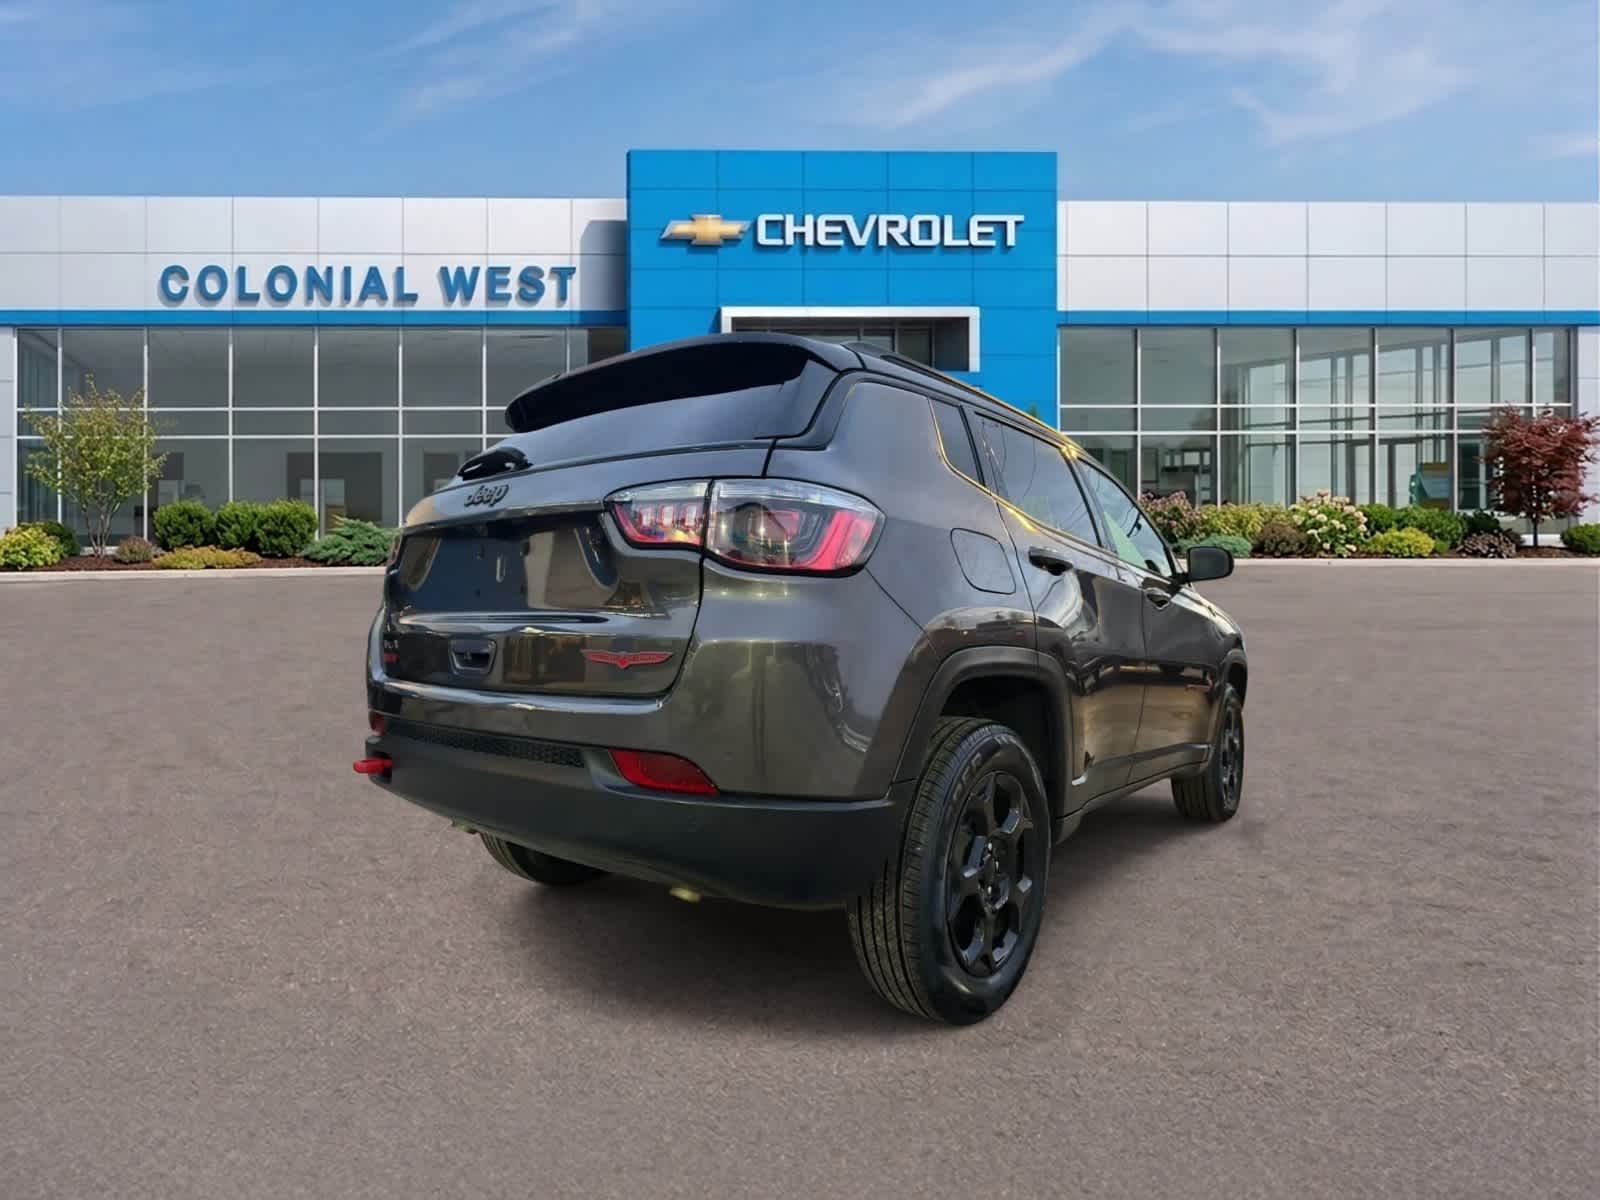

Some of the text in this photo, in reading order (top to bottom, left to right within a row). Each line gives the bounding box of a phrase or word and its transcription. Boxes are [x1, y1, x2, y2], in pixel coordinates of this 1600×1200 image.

[756, 213, 1025, 248] CHEVROLET
[159, 264, 577, 306] COLONIAL WEST
[464, 484, 509, 507] Jeep
